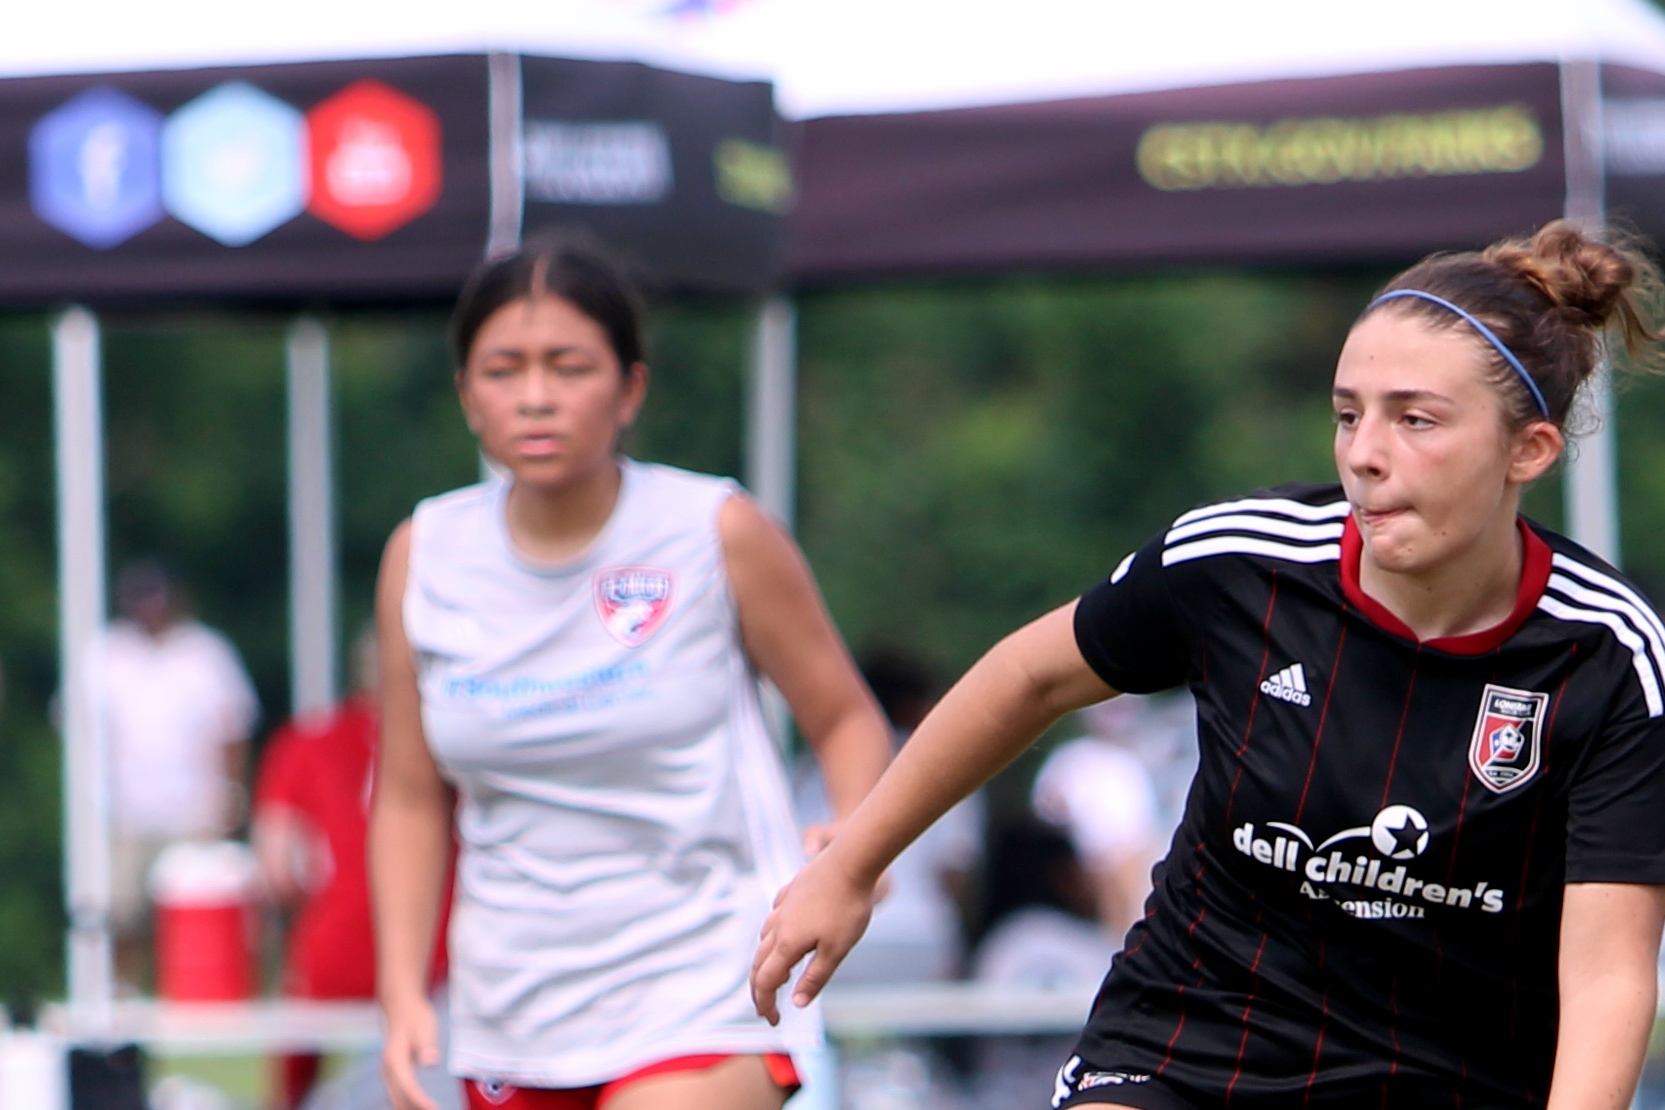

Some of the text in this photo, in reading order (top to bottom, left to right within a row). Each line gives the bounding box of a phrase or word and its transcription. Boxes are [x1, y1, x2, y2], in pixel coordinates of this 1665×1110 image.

[1260, 681, 1311, 706] adidas
[1233, 823, 1503, 912] dell children's
[1300, 881, 1424, 918] Asension
